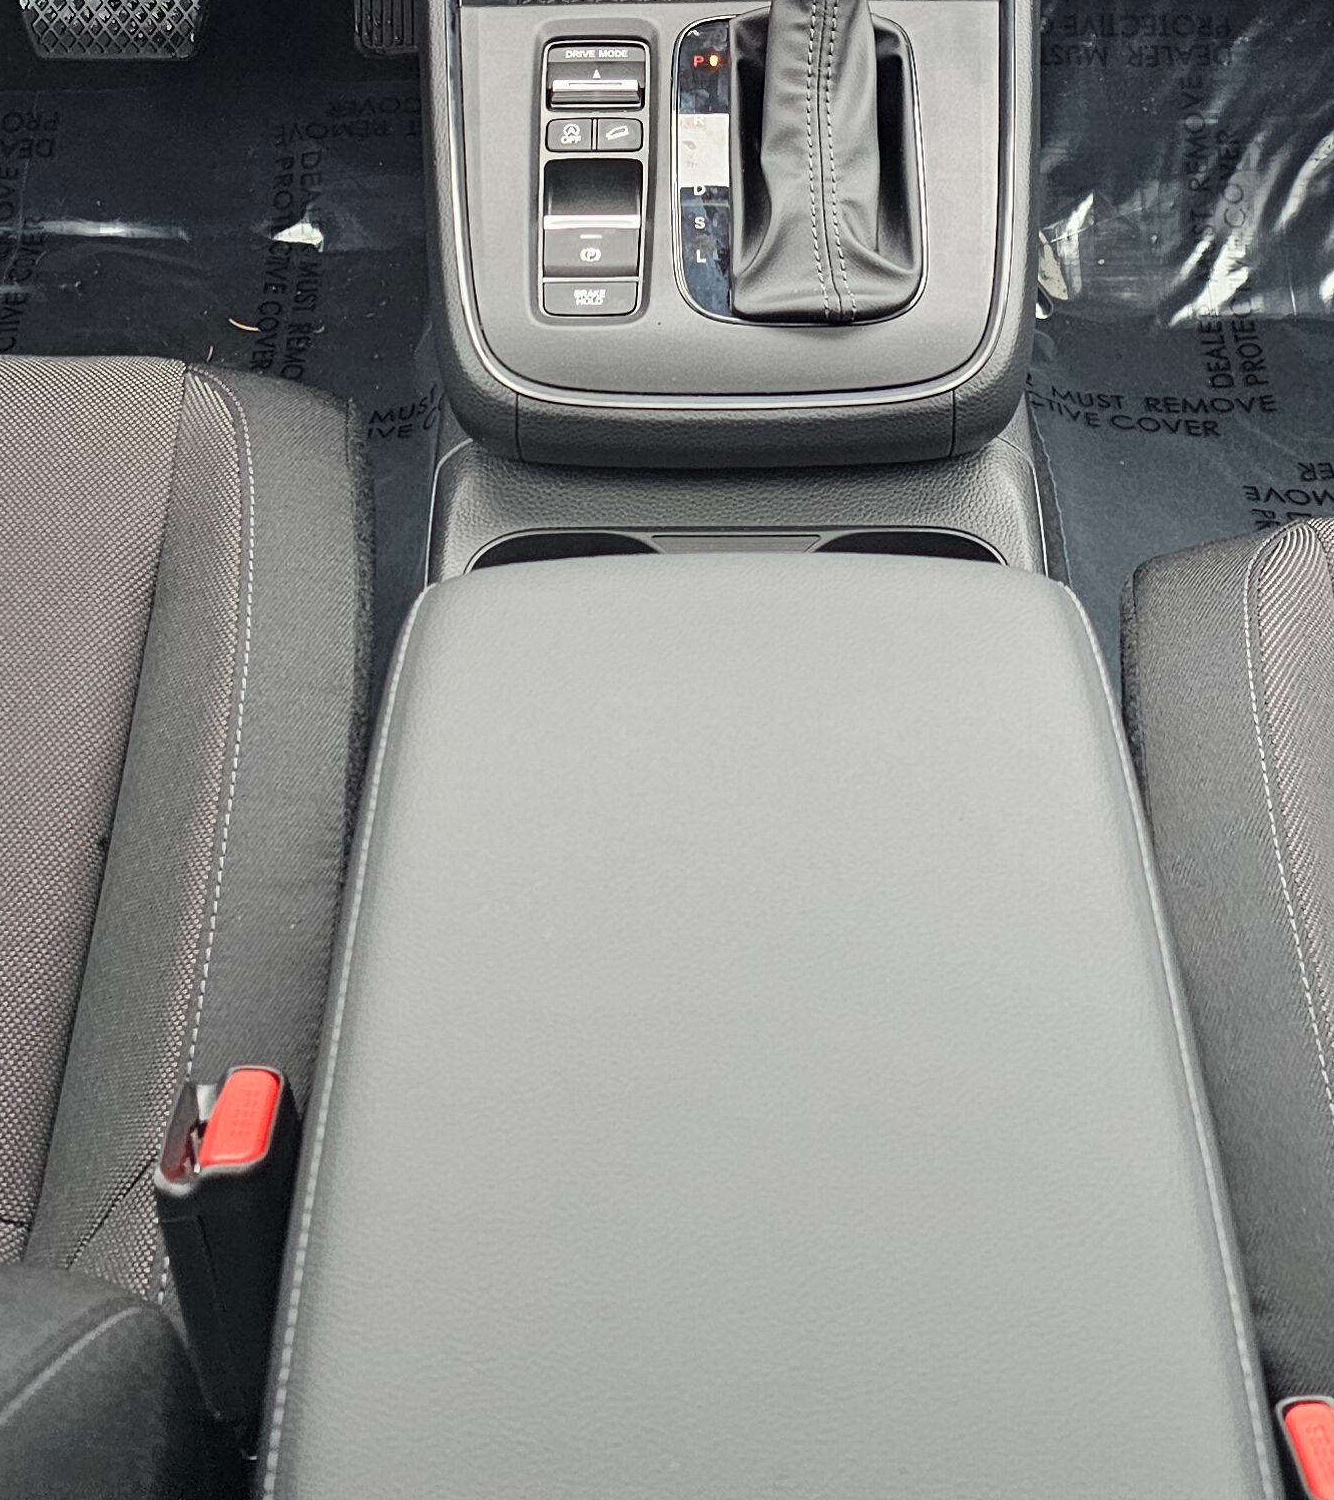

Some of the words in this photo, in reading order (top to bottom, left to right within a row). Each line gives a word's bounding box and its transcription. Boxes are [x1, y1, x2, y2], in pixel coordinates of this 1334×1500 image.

[565, 50, 596, 59] DRIVE
[598, 49, 628, 58] MODE
[693, 55, 705, 68] P
[560, 135, 582, 144] OFF
[694, 216, 705, 229] S
[696, 250, 706, 263] L
[574, 289, 606, 298] BRAKE
[575, 297, 604, 306] HOLD
[1051, 386, 1124, 410] MUST
[1144, 394, 1278, 415] REMOVE
[1110, 414, 1221, 438] COVER
